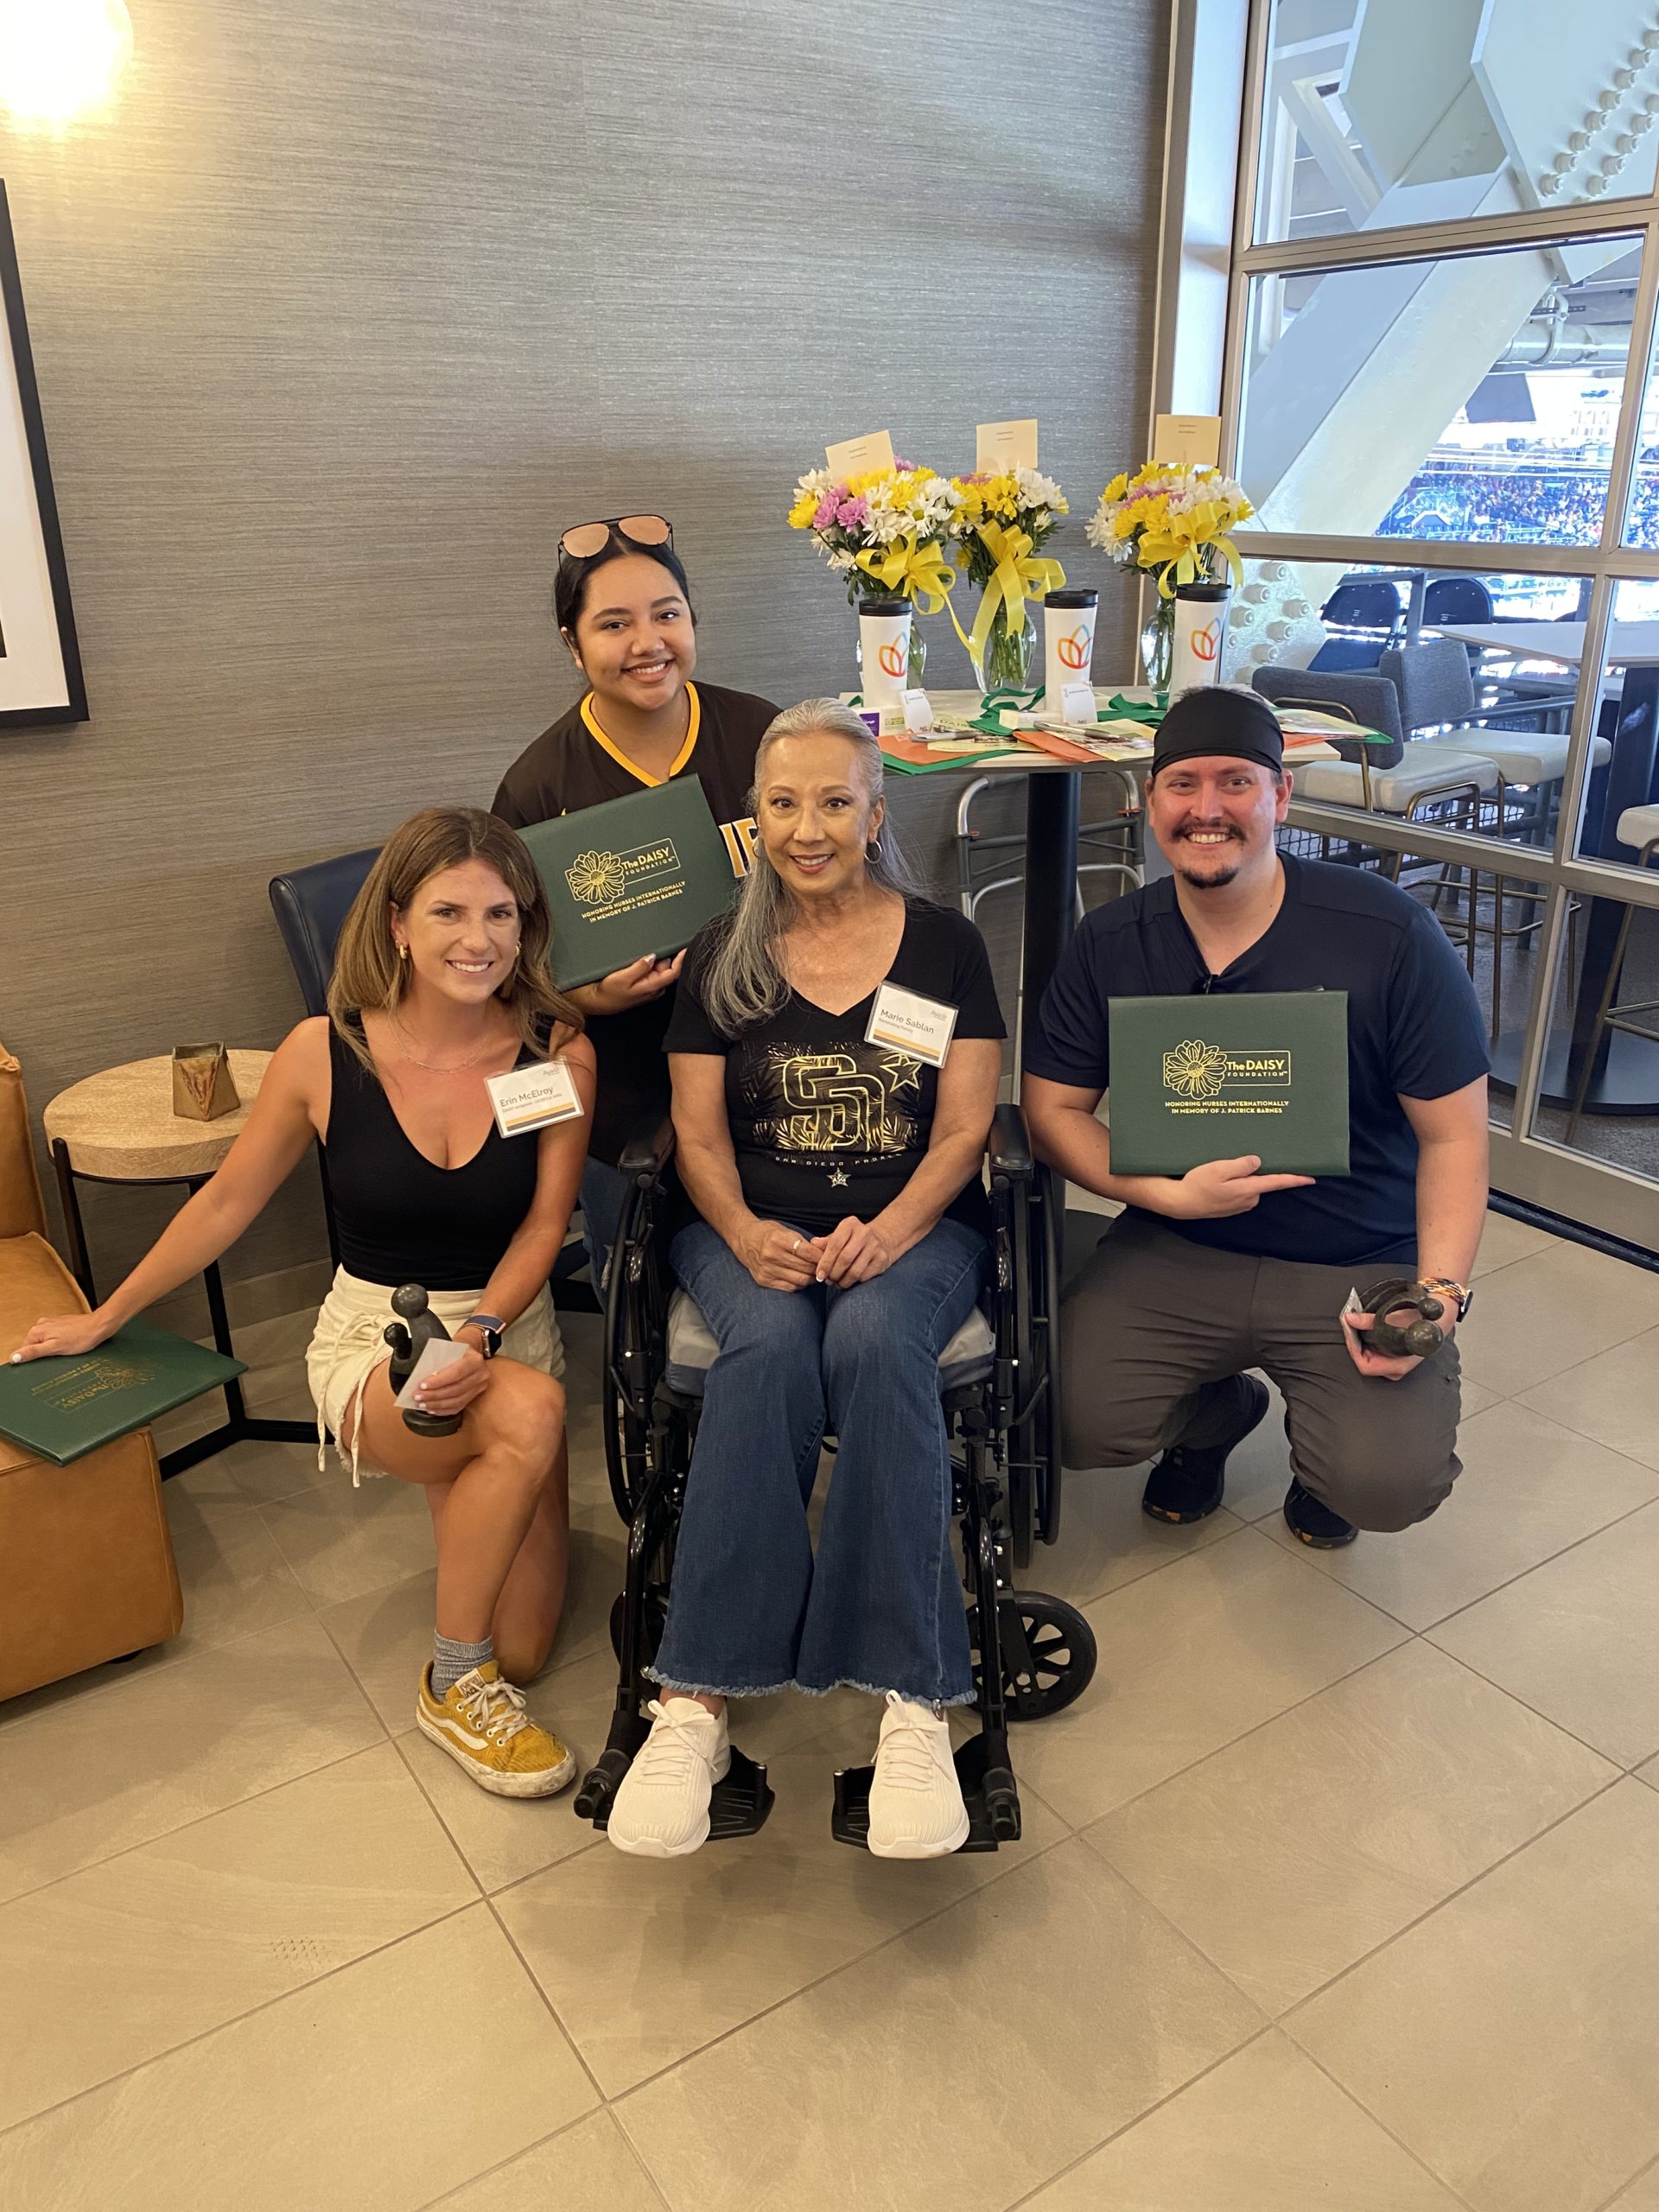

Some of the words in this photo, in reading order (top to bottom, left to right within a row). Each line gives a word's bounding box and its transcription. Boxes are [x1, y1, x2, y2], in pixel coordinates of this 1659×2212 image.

[621, 861, 639, 870] The
[638, 847, 669, 865] DAISY
[582, 905, 613, 918] HONORING
[613, 898, 635, 910] NURSES
[636, 881, 685, 901] INTERNATIONALLY
[597, 908, 621, 921] MEMORY
[638, 897, 661, 907] PATRICK
[661, 889, 683, 899] BARNES
[880, 1009, 905, 1023] Marie
[906, 1018, 934, 1034] Sablan
[1226, 1061, 1245, 1071] The
[1246, 1059, 1285, 1071] DAISY
[499, 1096, 518, 1107] Erin
[518, 1086, 553, 1103] McElroy
